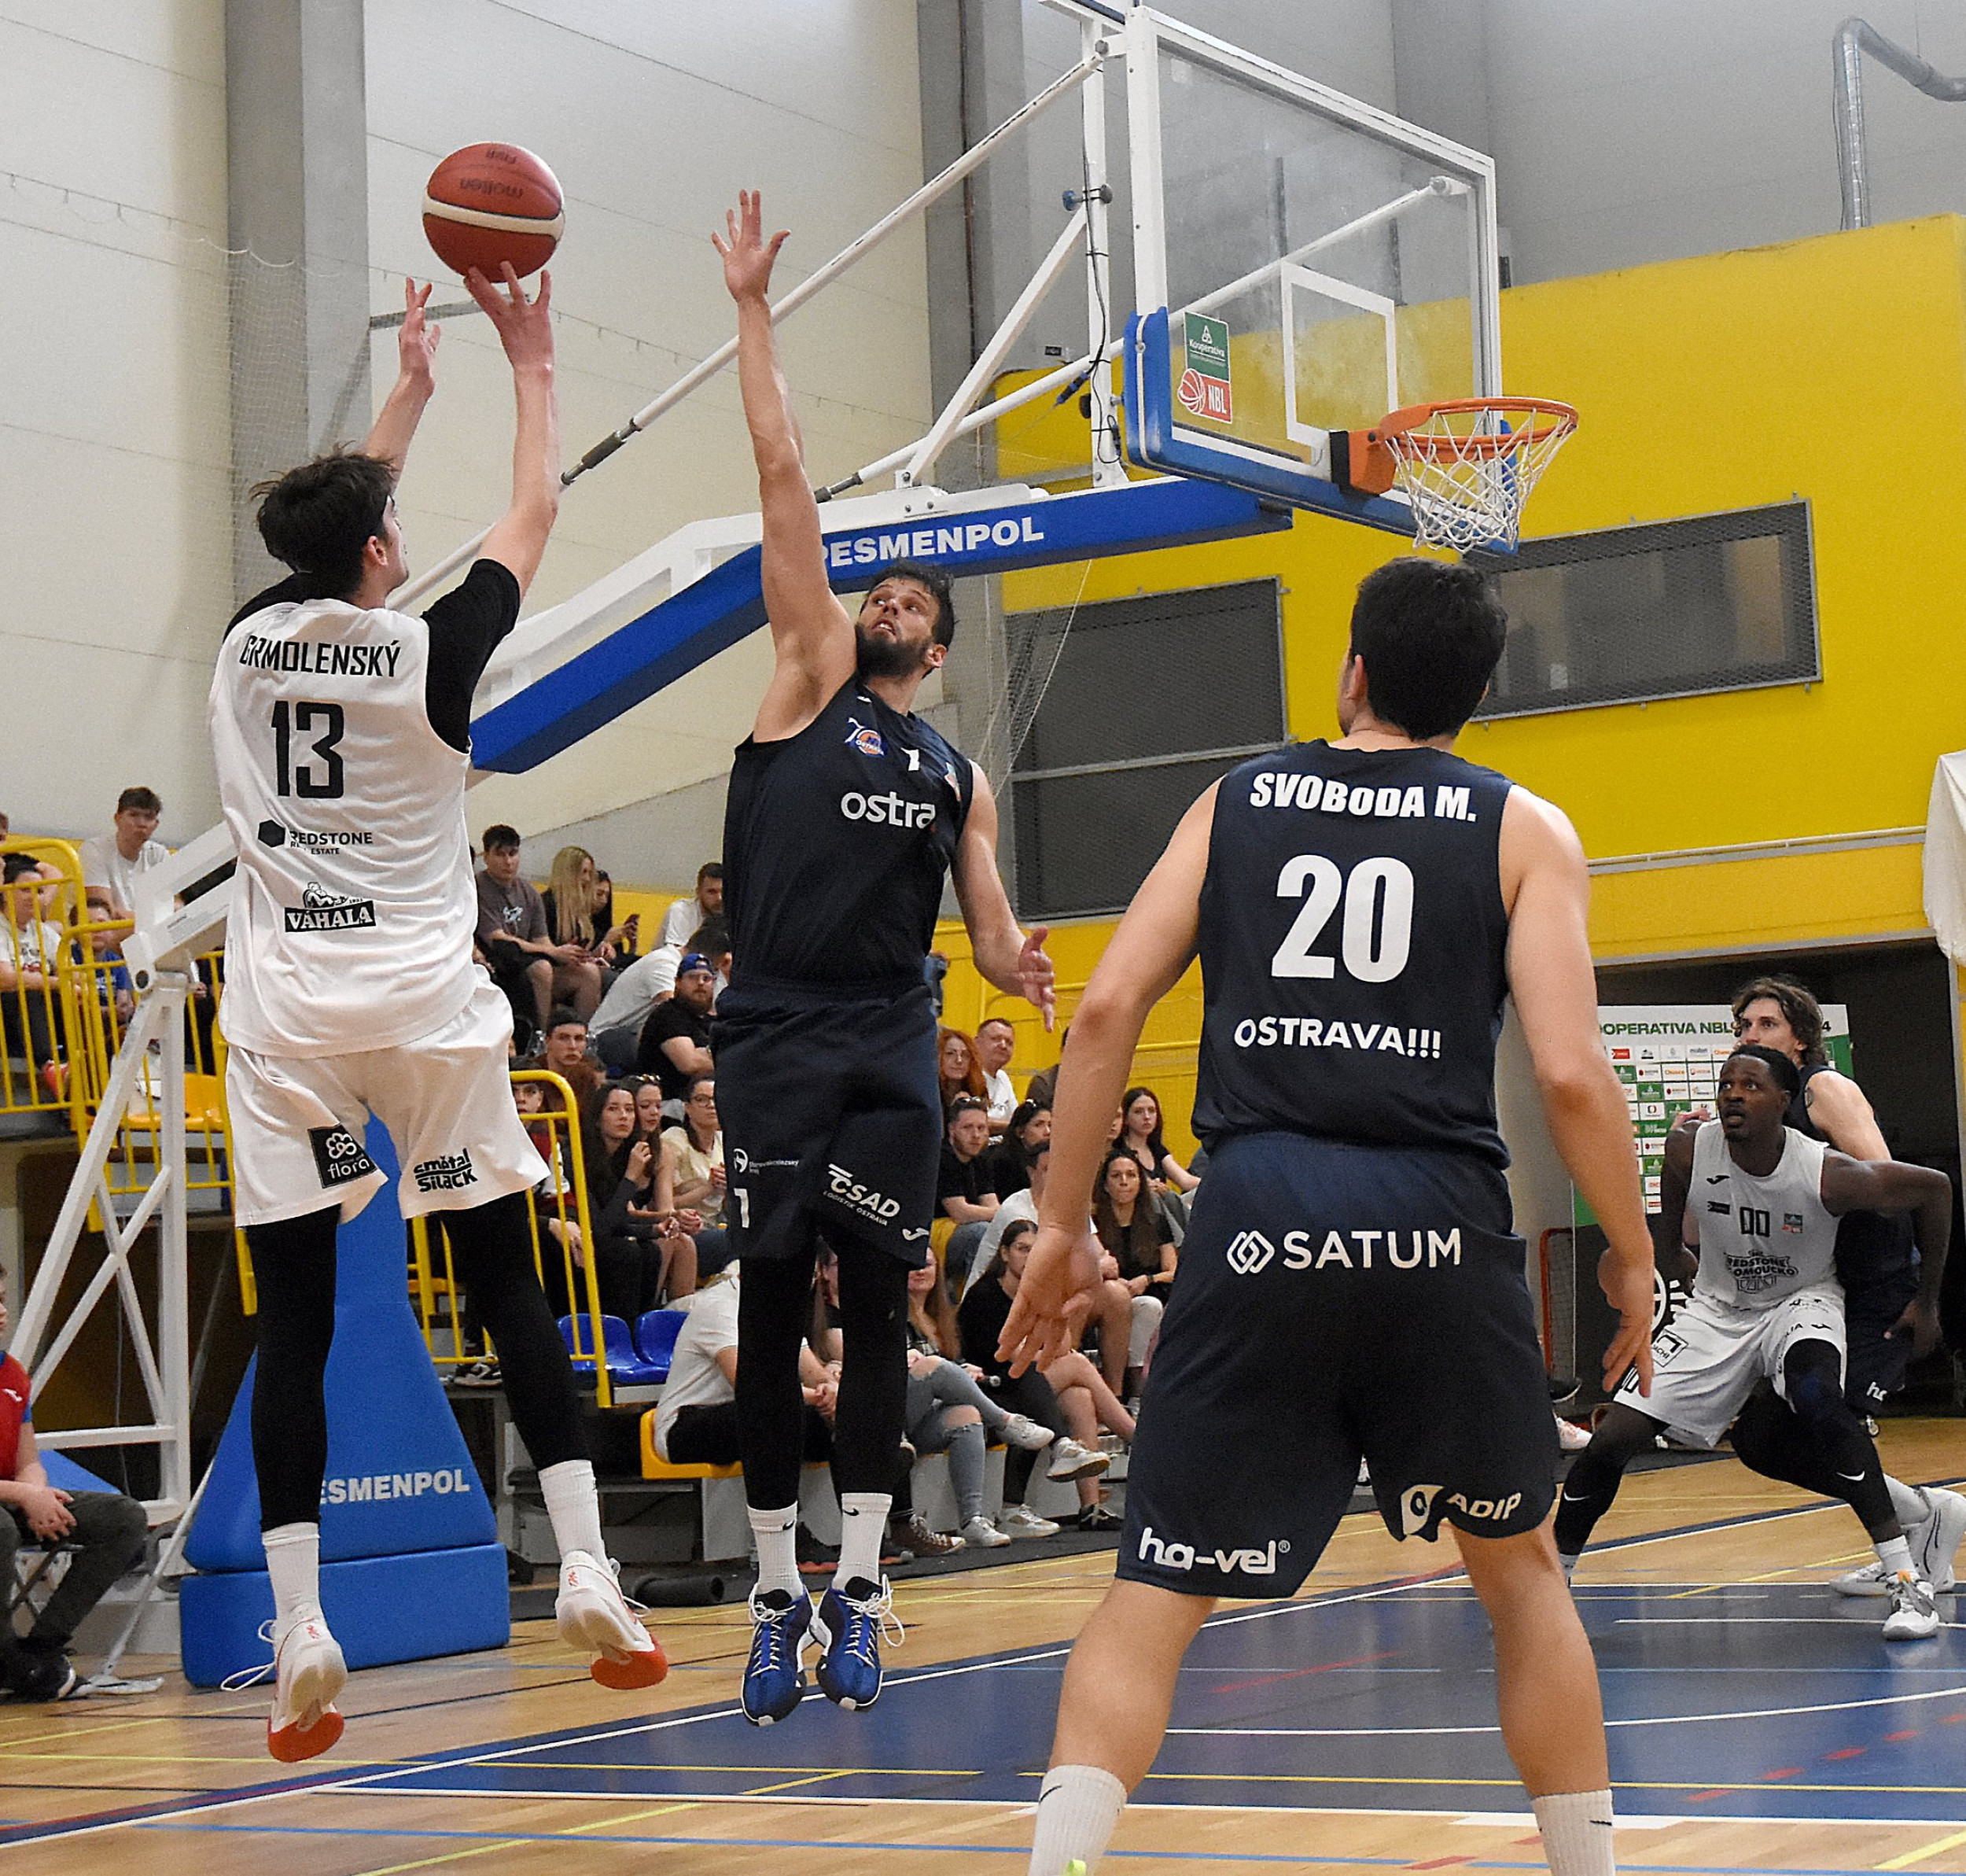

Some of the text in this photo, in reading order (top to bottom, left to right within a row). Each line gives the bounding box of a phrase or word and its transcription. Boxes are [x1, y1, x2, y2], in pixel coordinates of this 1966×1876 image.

[1189, 338, 1225, 357] Kooperativa
[1208, 385, 1227, 415] NBL
[823, 516, 1045, 567] ESMENPOL
[271, 700, 344, 798] 13
[1250, 772, 1477, 822] SVOBODA M.
[289, 831, 373, 846] REDSTONE
[1271, 854, 1414, 982] 20
[1234, 1016, 1441, 1059] OSTRAVA!!!
[1600, 1023, 1696, 1035] OPERATIVA
[1700, 1022, 1732, 1034] NBL
[327, 1159, 370, 1179] flora
[1283, 1228, 1461, 1269] SATUM
[1732, 1265, 1795, 1277] OMOUCKO
[1446, 1492, 1522, 1520] ADIP
